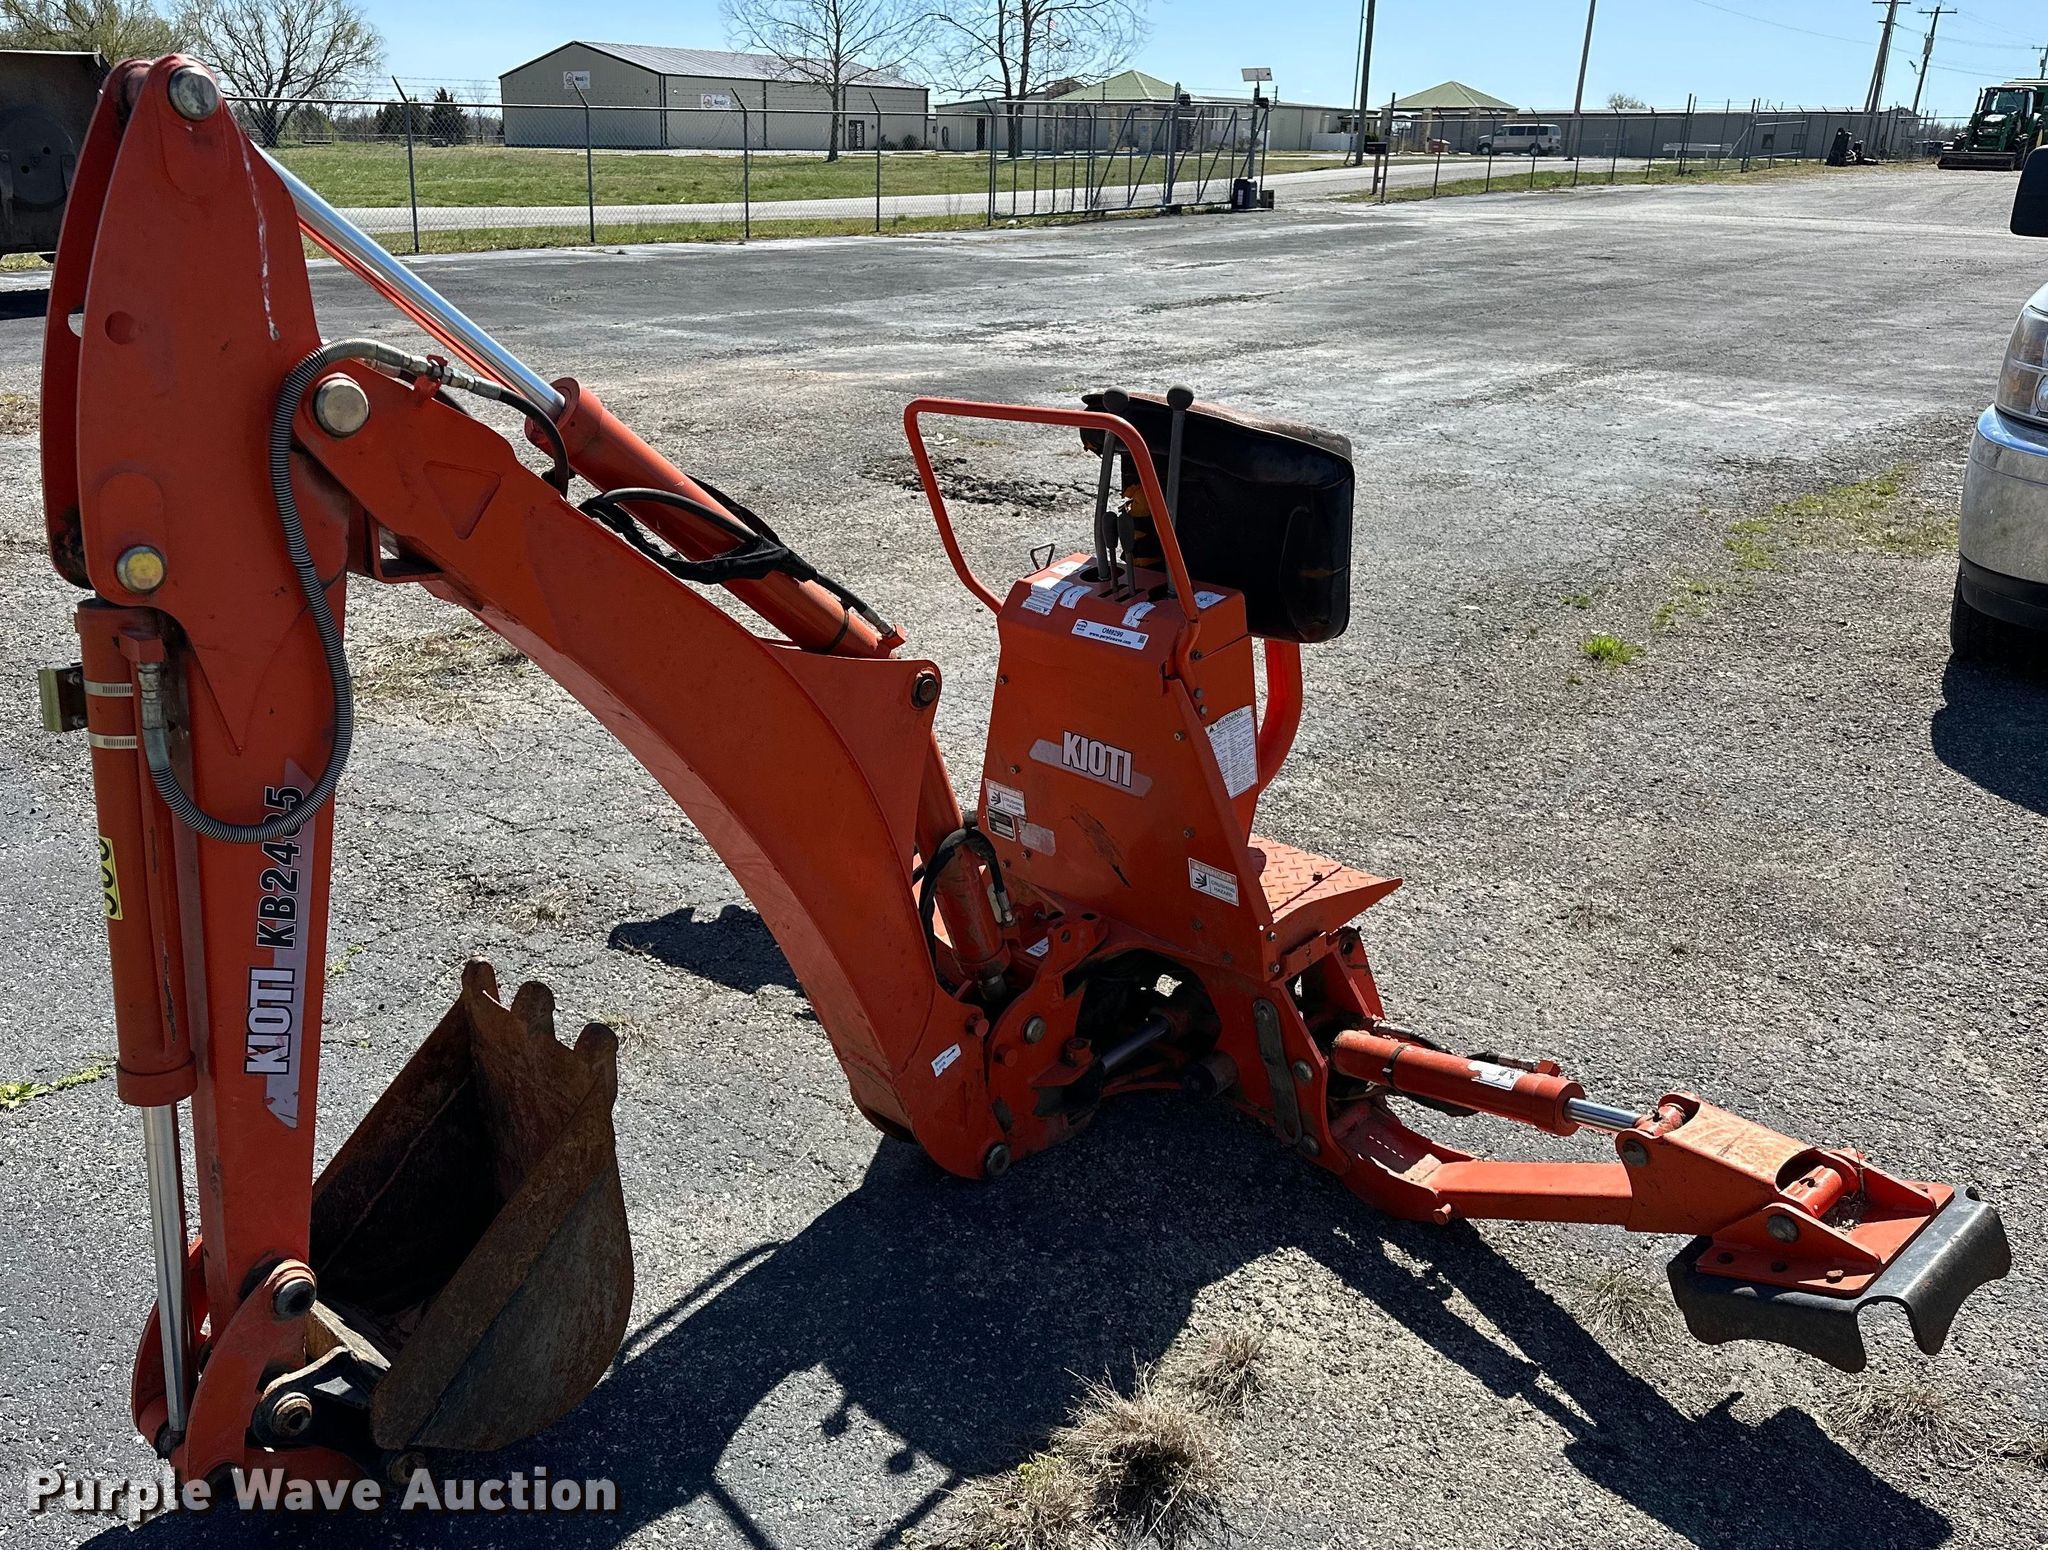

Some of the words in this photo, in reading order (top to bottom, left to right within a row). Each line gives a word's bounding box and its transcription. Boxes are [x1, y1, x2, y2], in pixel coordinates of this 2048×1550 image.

[1216, 710, 1243, 728] WARNING
[1062, 729, 1133, 788] KIOTI
[244, 966, 295, 1075] KIOTI
